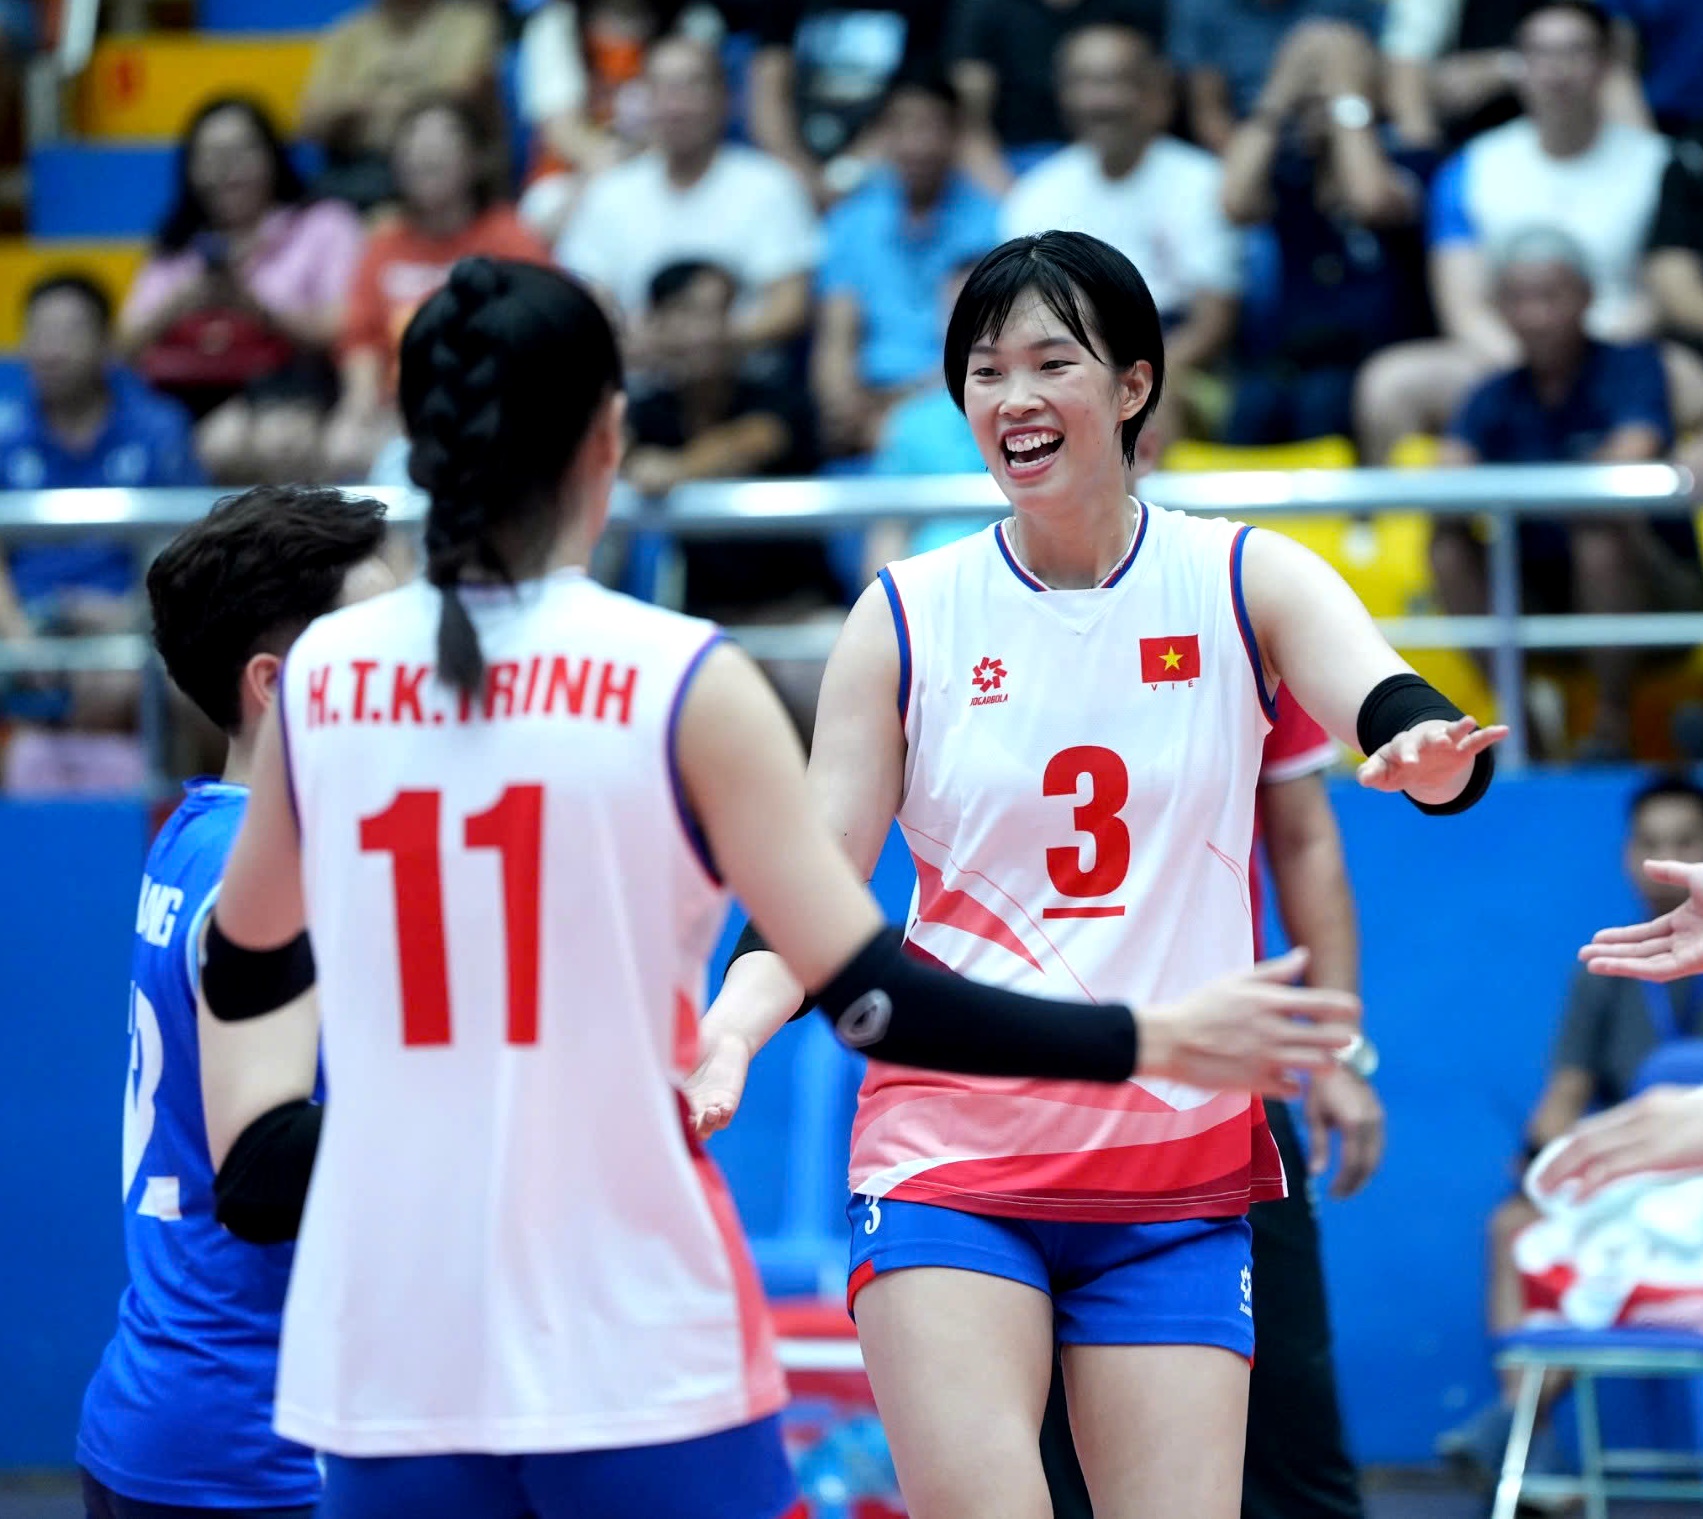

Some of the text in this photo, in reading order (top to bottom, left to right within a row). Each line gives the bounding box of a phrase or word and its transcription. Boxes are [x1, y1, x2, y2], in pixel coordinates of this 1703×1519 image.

[1150, 680, 1194, 691] VIE
[1042, 745, 1131, 898] 3
[358, 784, 545, 1046] 11
[864, 1195, 882, 1235] 3
